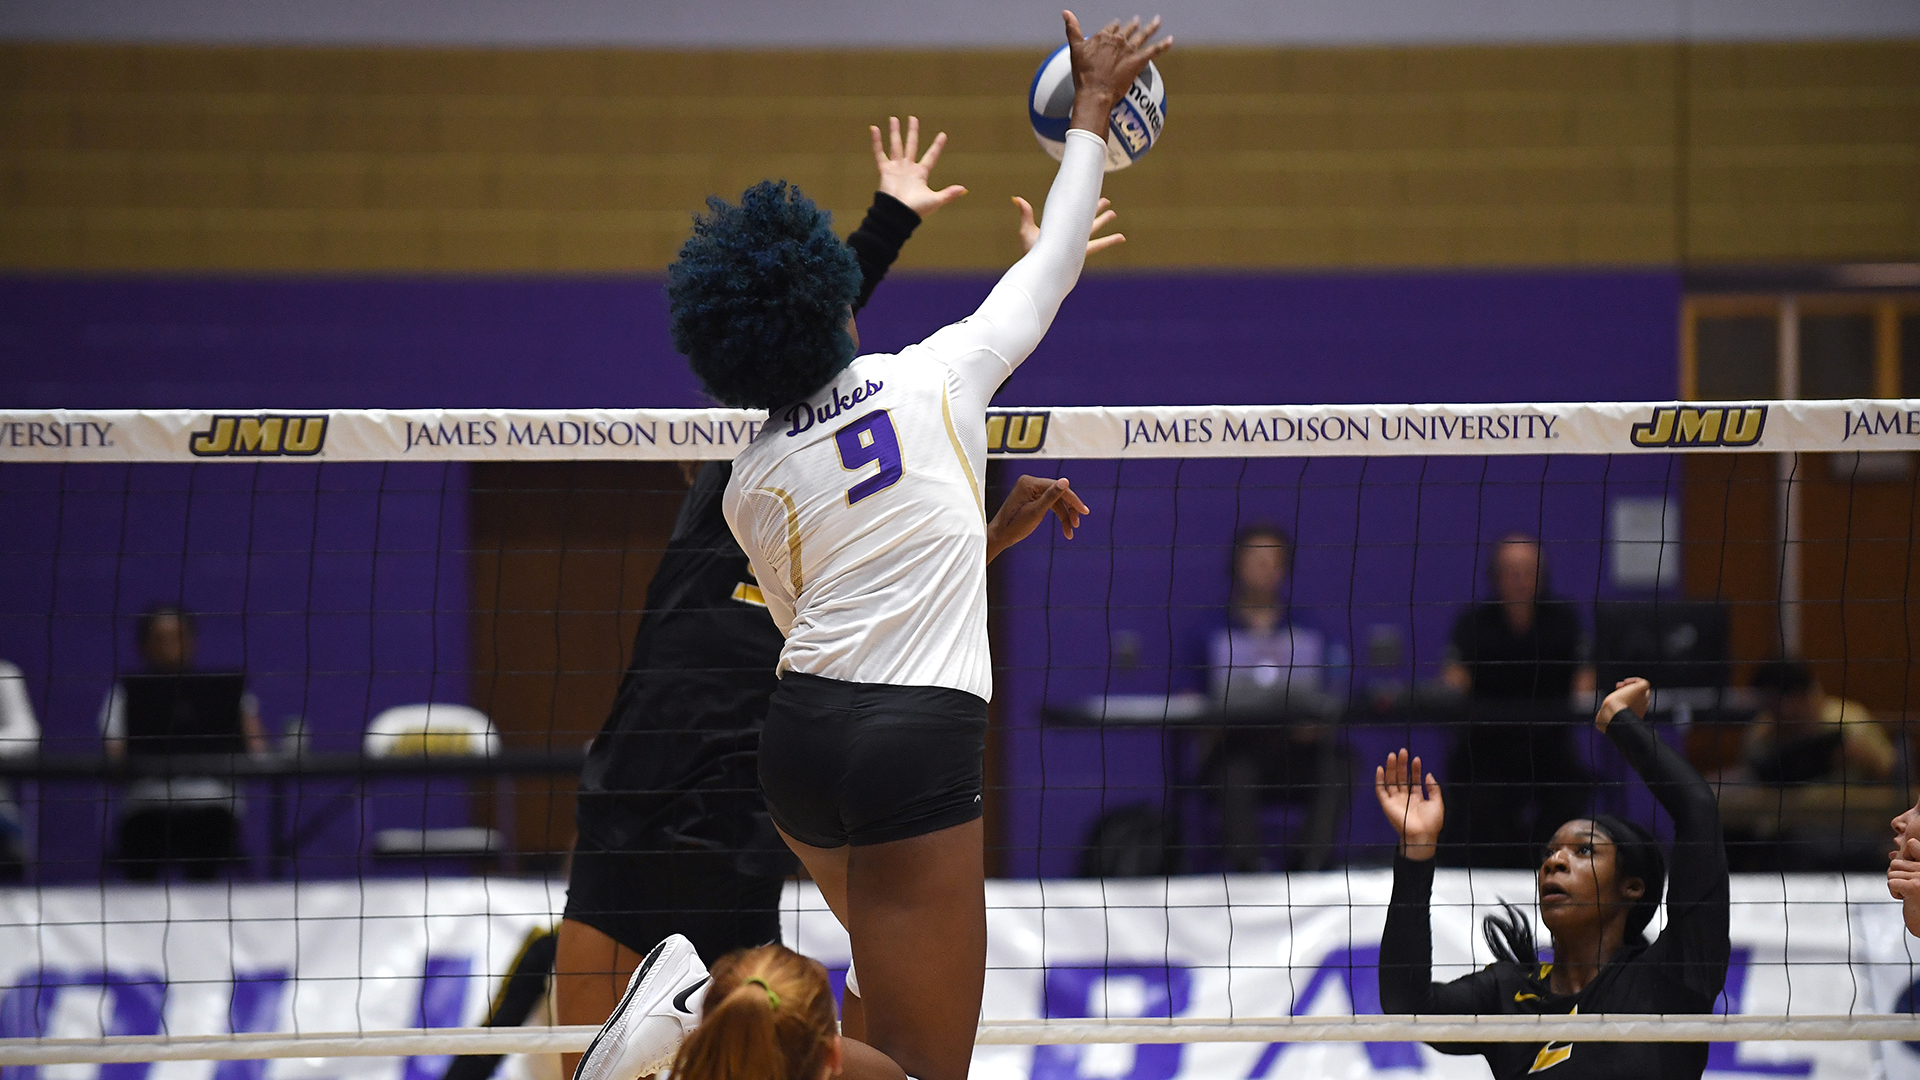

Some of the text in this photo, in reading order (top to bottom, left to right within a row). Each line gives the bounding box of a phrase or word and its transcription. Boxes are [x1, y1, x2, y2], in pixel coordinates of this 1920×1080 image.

[786, 379, 883, 437] Dukes
[1630, 405, 1768, 447] JMU
[189, 414, 329, 456] JMU
[403, 420, 497, 452] JAMES
[506, 419, 658, 446] MADISON
[1121, 417, 1213, 450] JAMES
[1222, 415, 1370, 442] MADISON
[833, 407, 906, 509] 9
